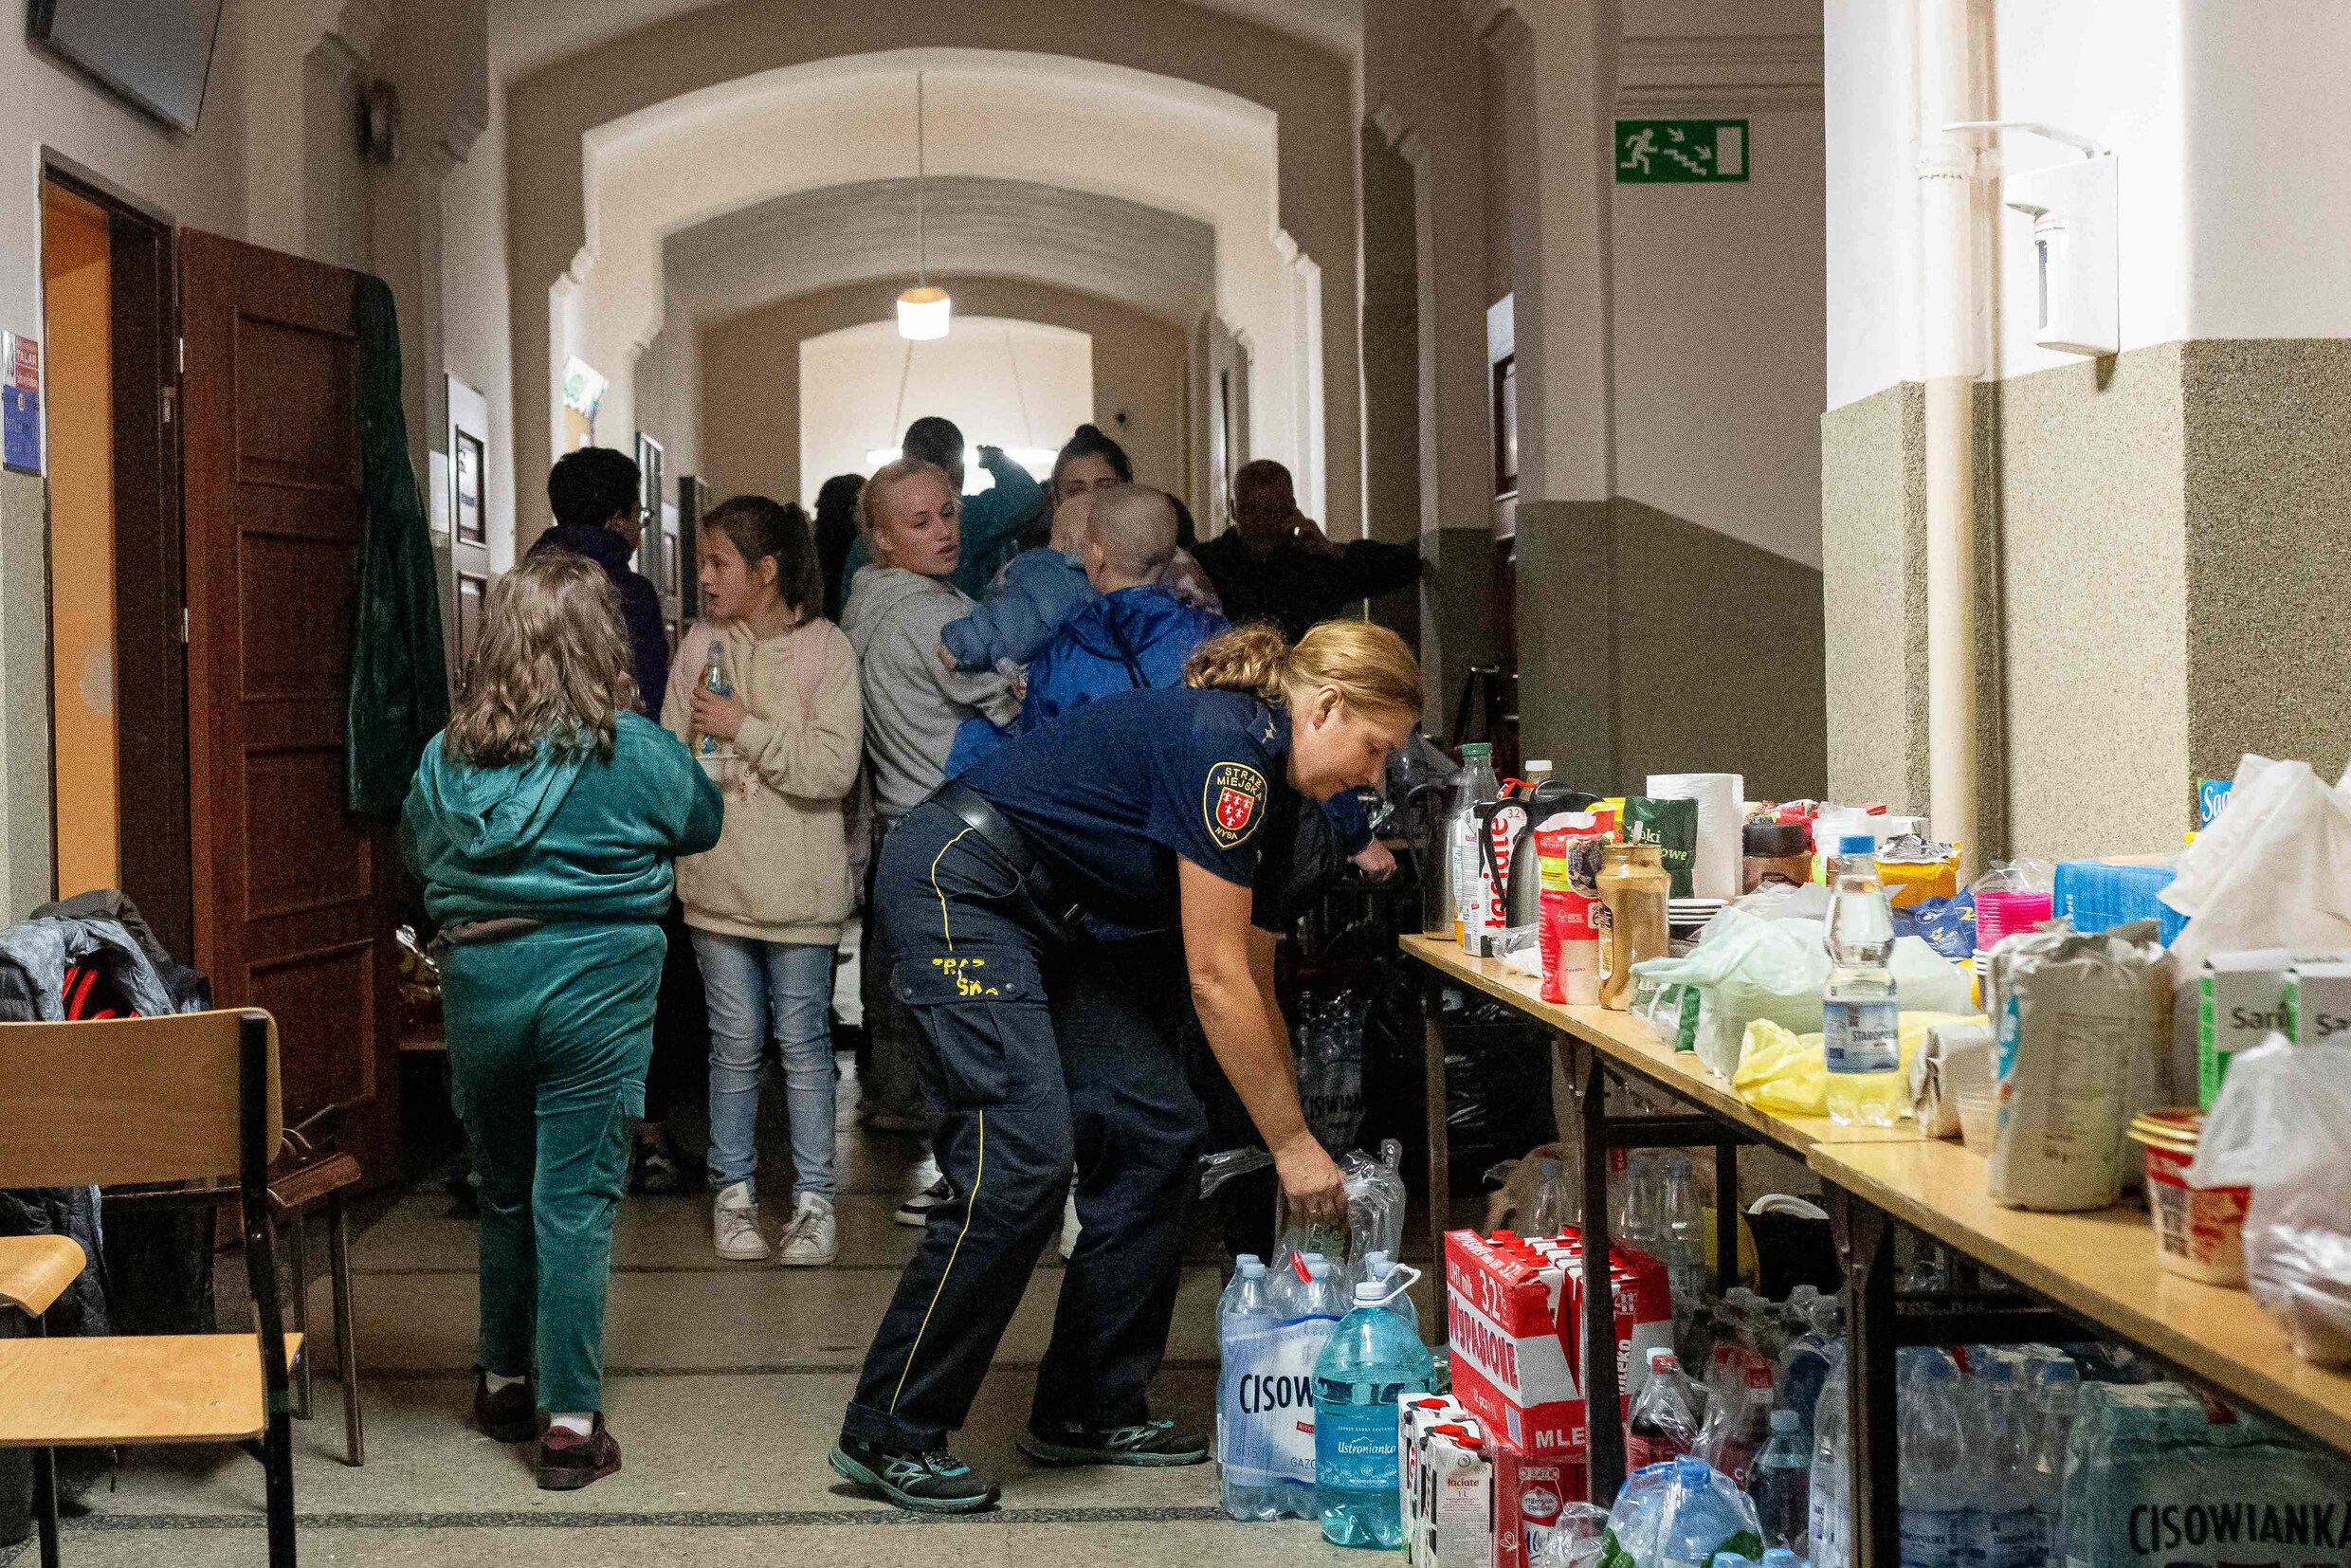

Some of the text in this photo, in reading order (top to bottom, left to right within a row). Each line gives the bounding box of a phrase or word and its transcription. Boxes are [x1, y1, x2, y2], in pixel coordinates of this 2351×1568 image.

[1216, 775, 1262, 801] MIEJSKA
[1215, 827, 1238, 840] NYSA
[1338, 1441, 1396, 1454] Ustronianka
